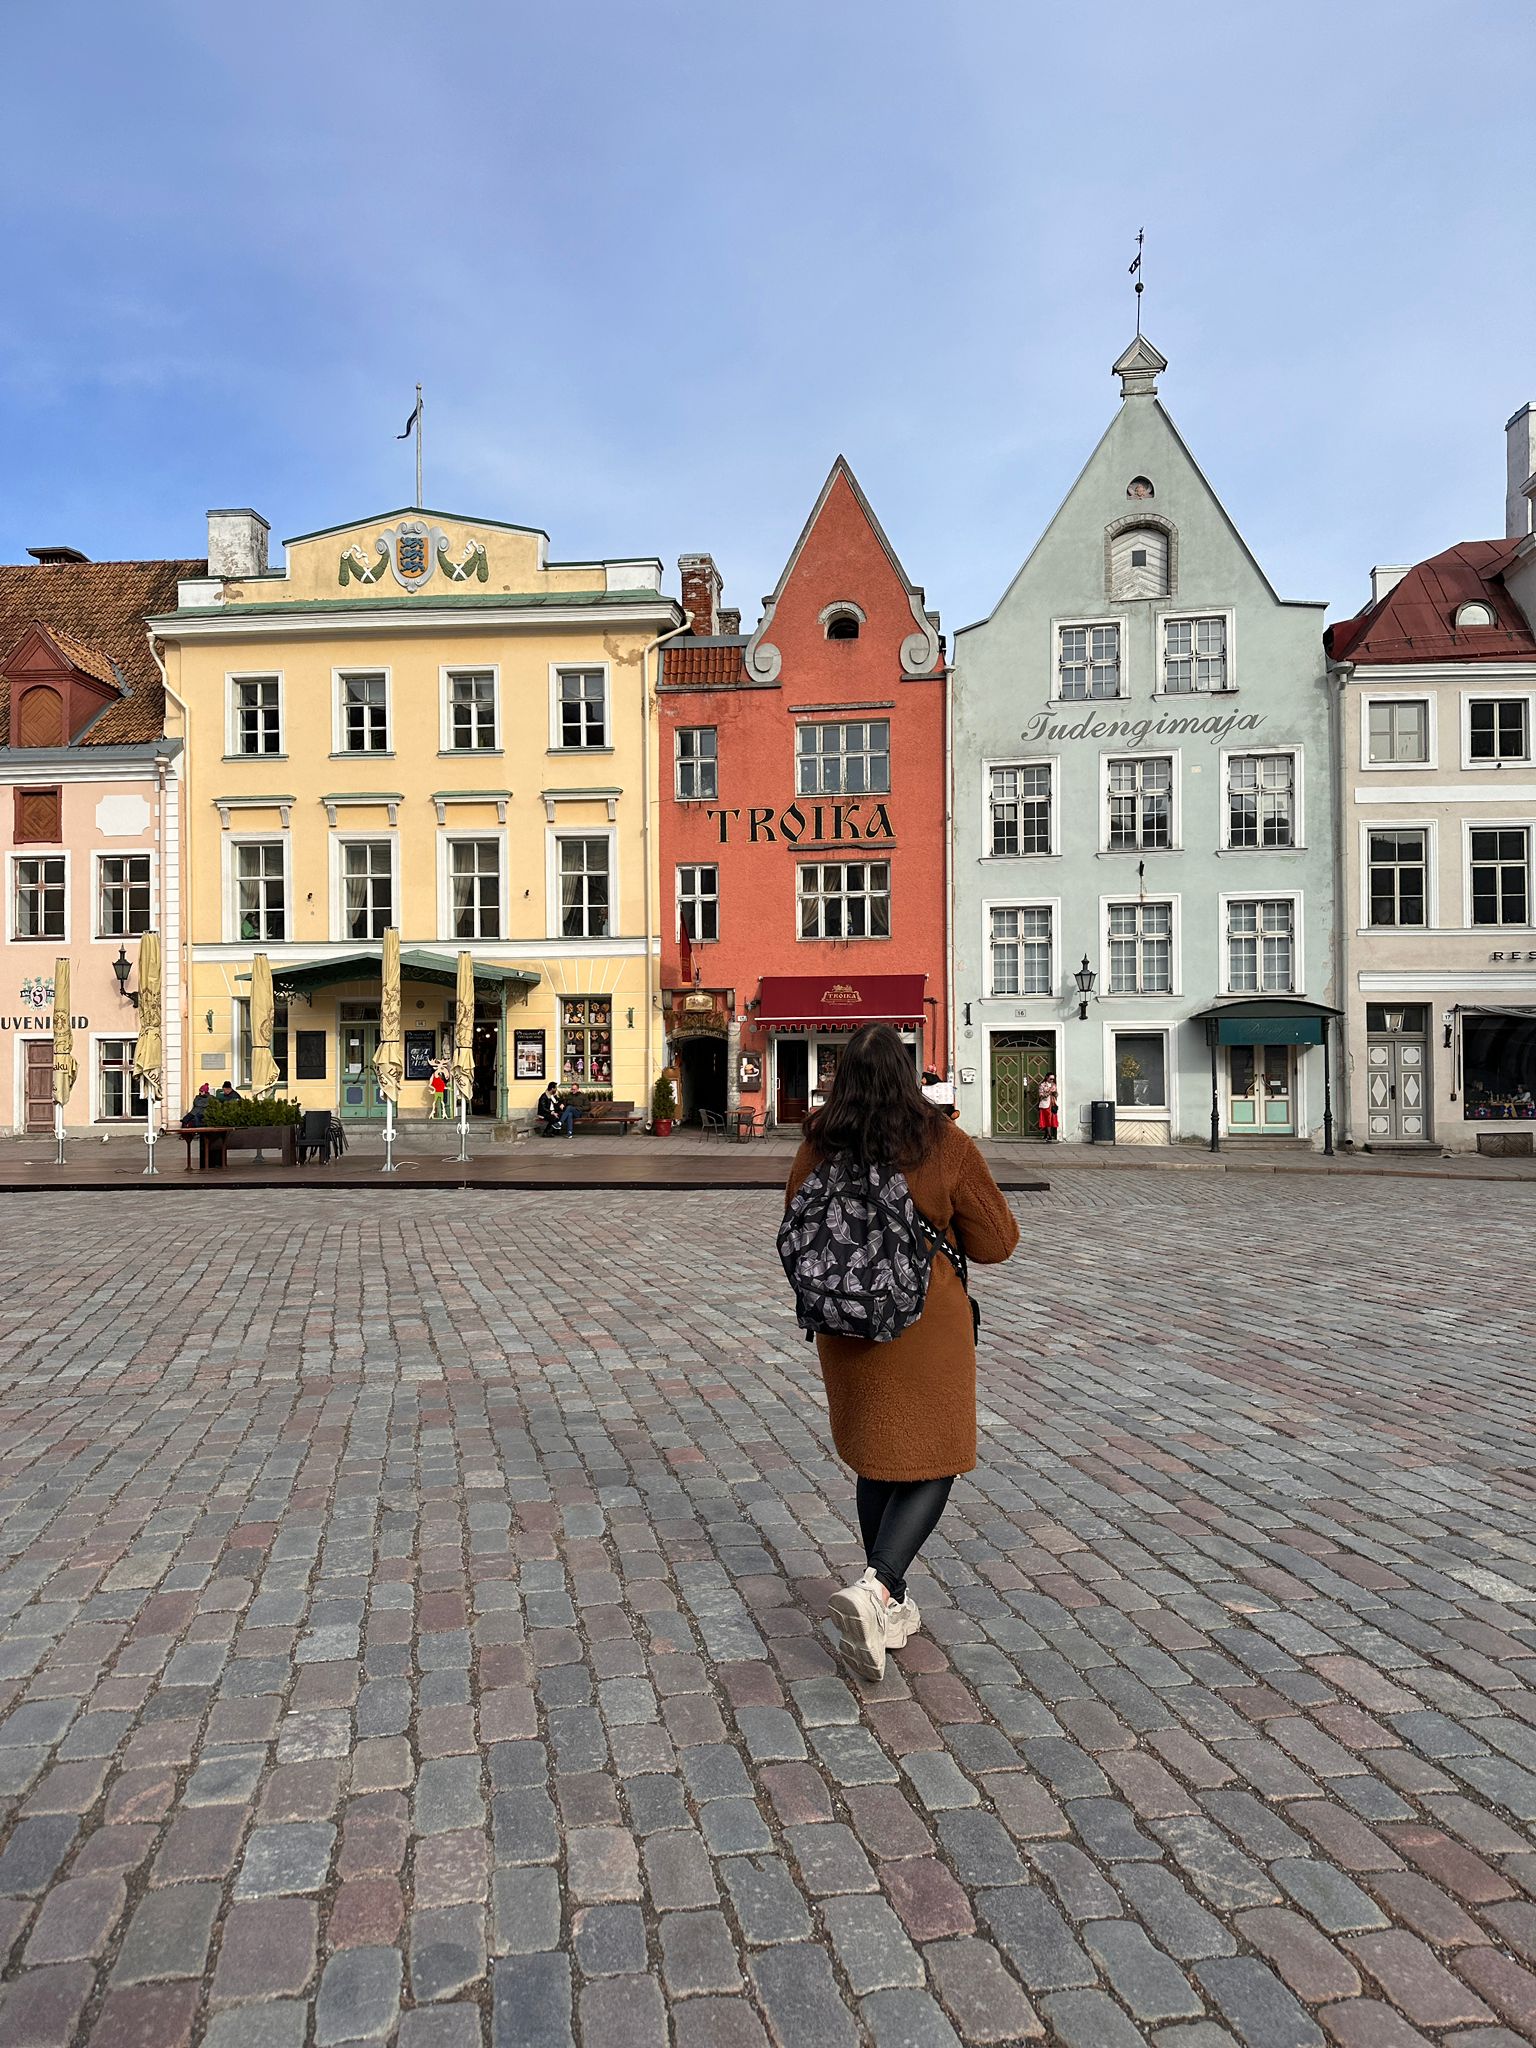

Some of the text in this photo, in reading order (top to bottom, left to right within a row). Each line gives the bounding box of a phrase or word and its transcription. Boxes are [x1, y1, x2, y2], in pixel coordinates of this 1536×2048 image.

[1020, 708, 1270, 747] Tudengimaja
[706, 802, 897, 844] TROIKA
[53, 1062, 68, 1071] aku
